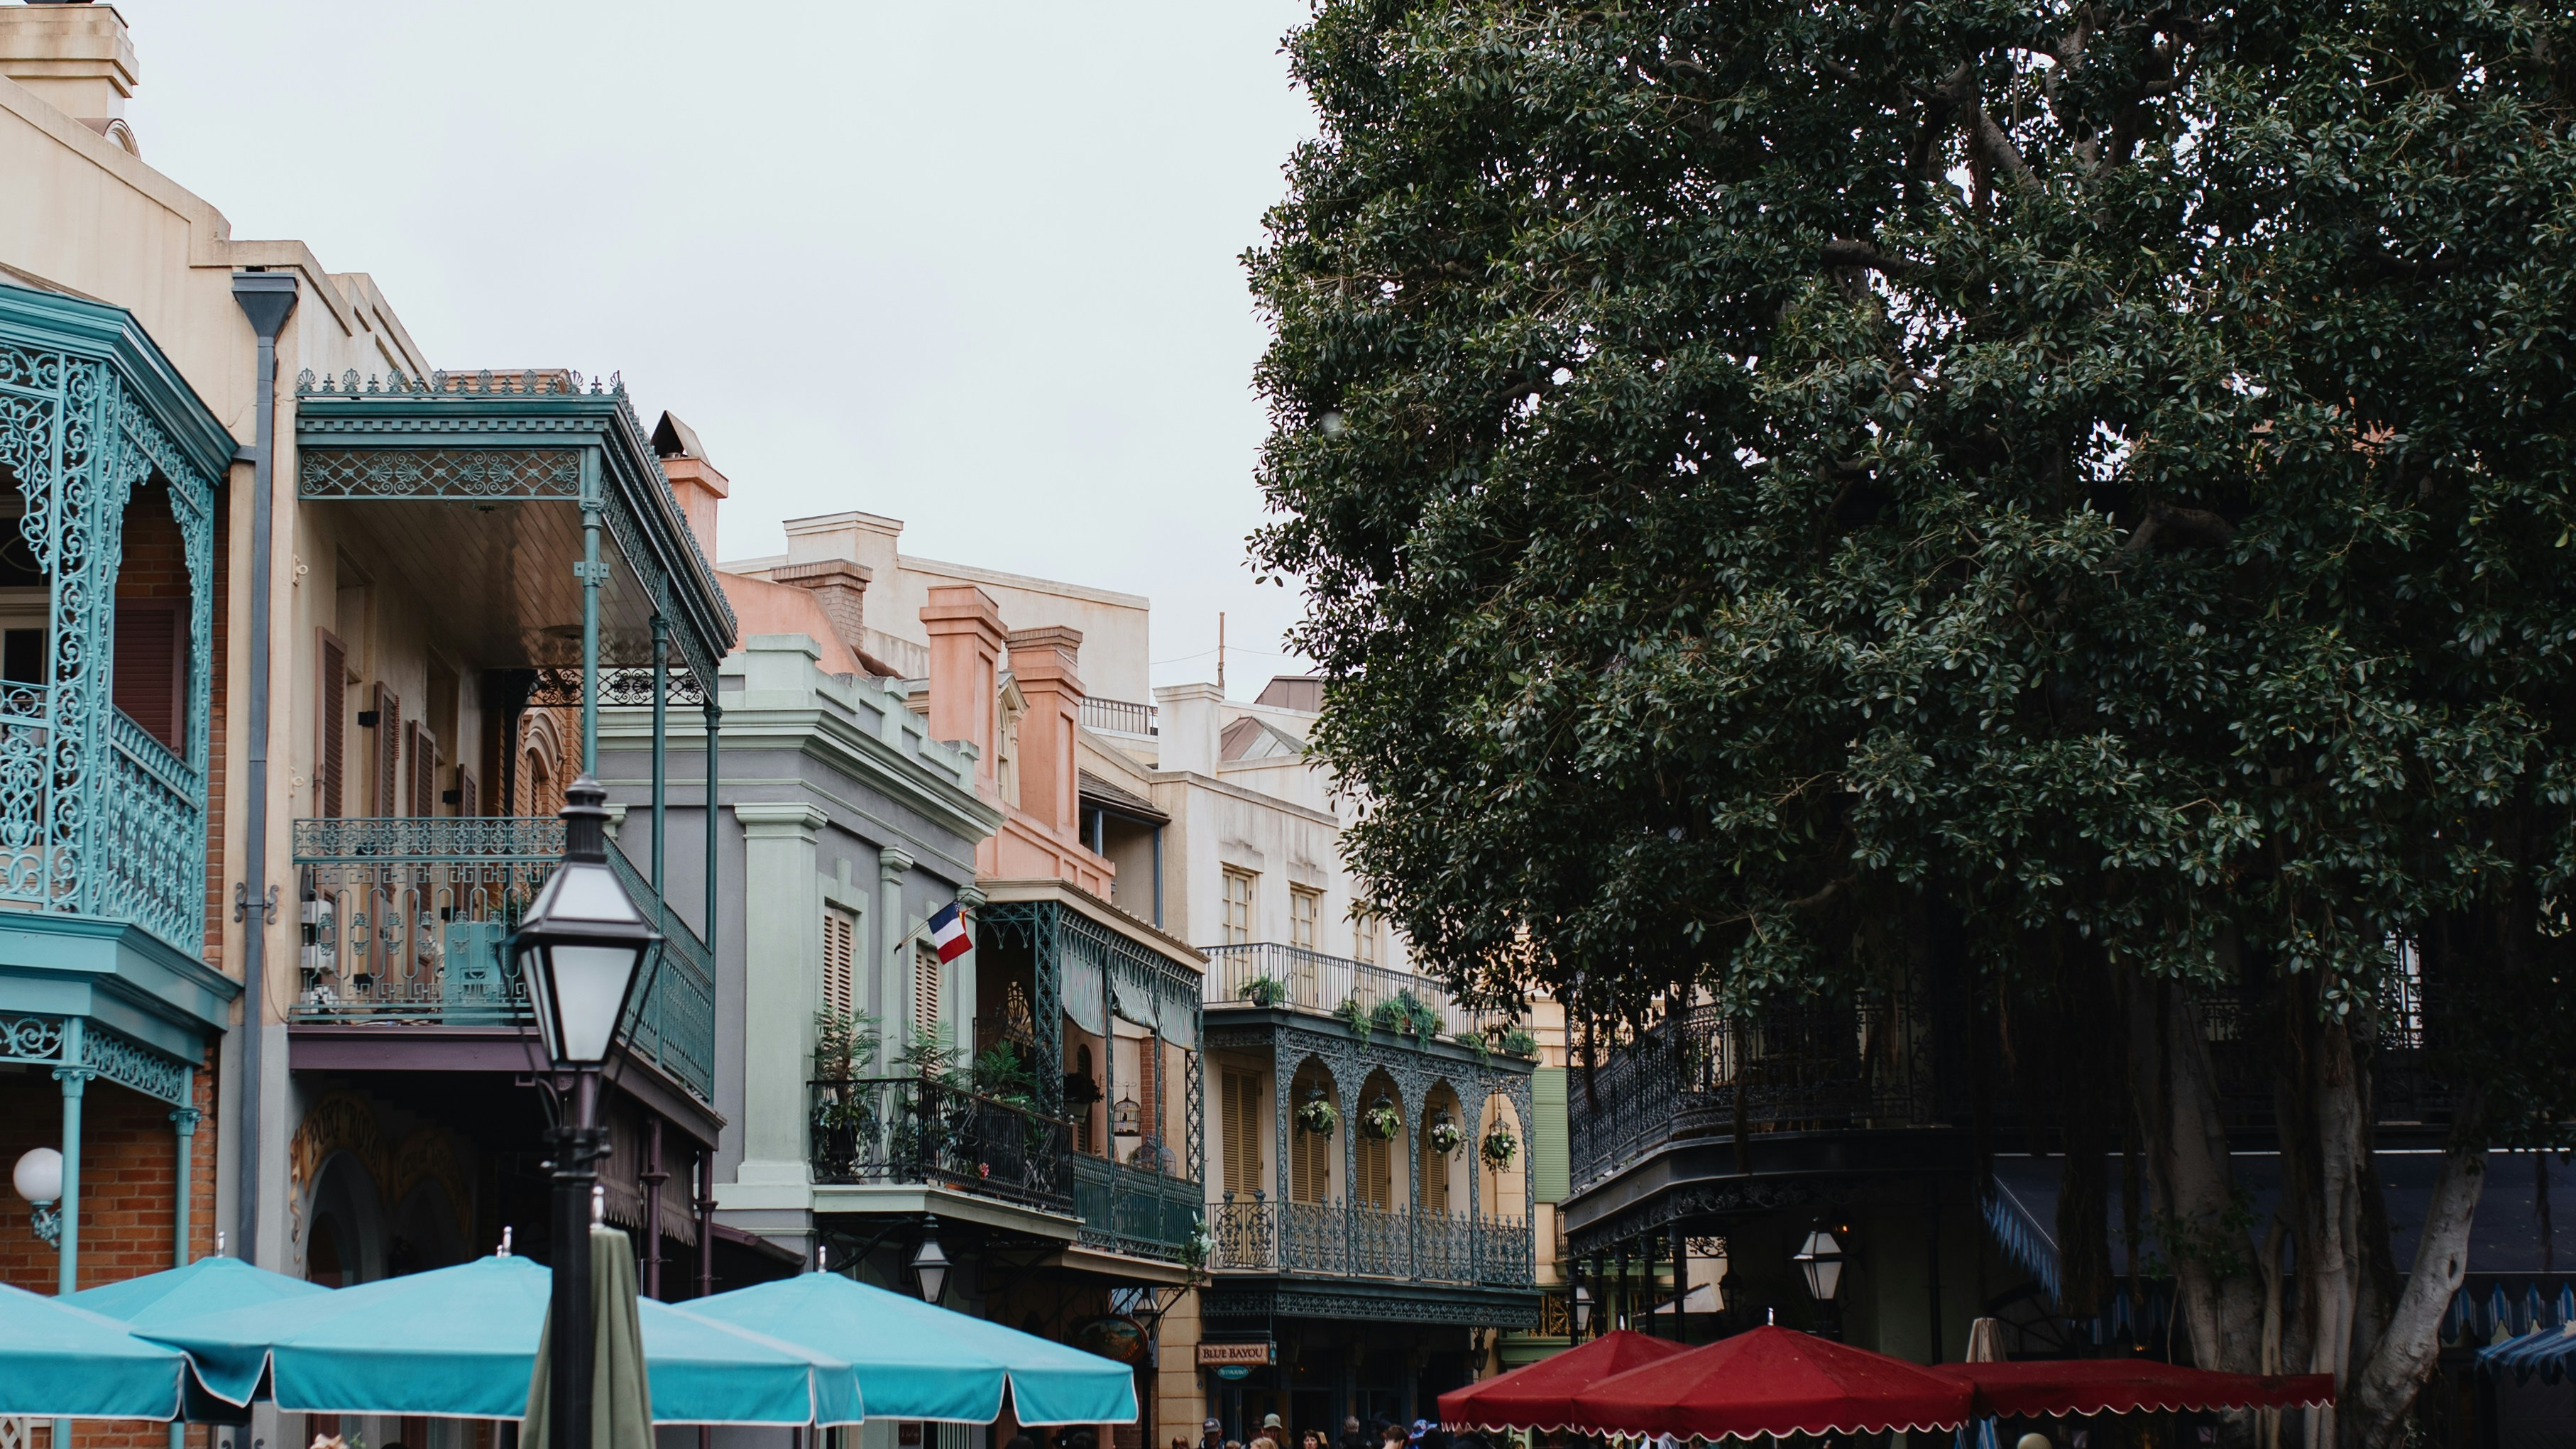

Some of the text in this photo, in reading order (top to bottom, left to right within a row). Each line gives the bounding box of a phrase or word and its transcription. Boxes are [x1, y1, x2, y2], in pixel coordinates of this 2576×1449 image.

[308, 1098, 342, 1165] PORT
[1203, 1349, 1227, 1359] BLUE
[1229, 1347, 1263, 1358] BAYOU
